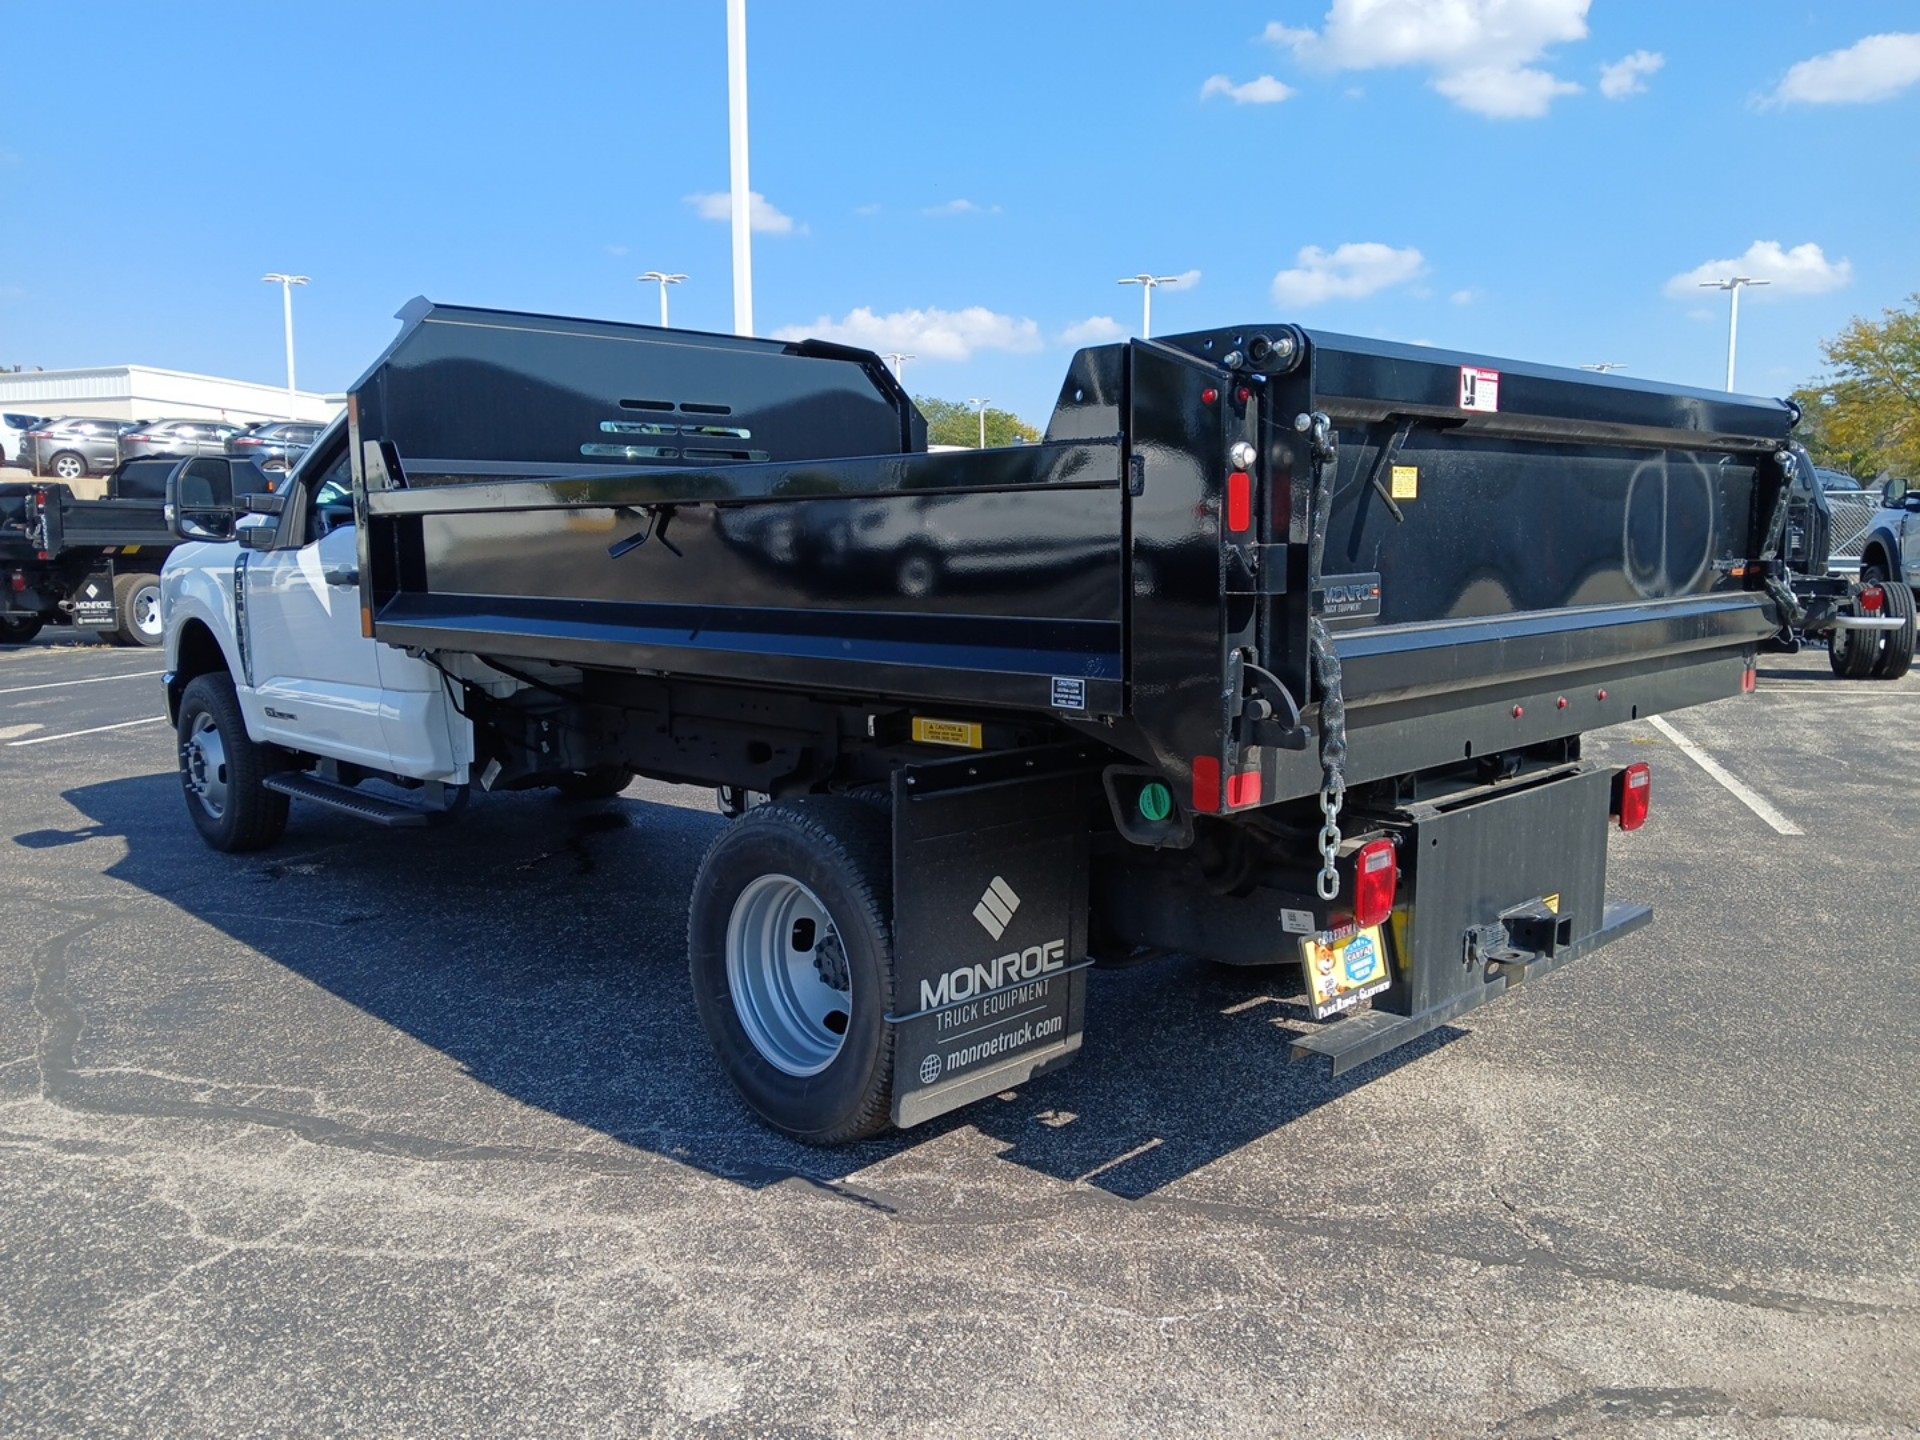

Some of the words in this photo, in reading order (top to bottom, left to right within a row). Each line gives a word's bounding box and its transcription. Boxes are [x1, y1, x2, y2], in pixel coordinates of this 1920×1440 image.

[75, 601, 112, 609] MONROE
[1322, 583, 1379, 604] MONROE
[920, 939, 1064, 1012] MONROE
[936, 1003, 979, 1031] TRUCK
[983, 979, 1050, 1017] EQUIPMENT
[947, 1015, 1062, 1071] monroetruck.com
